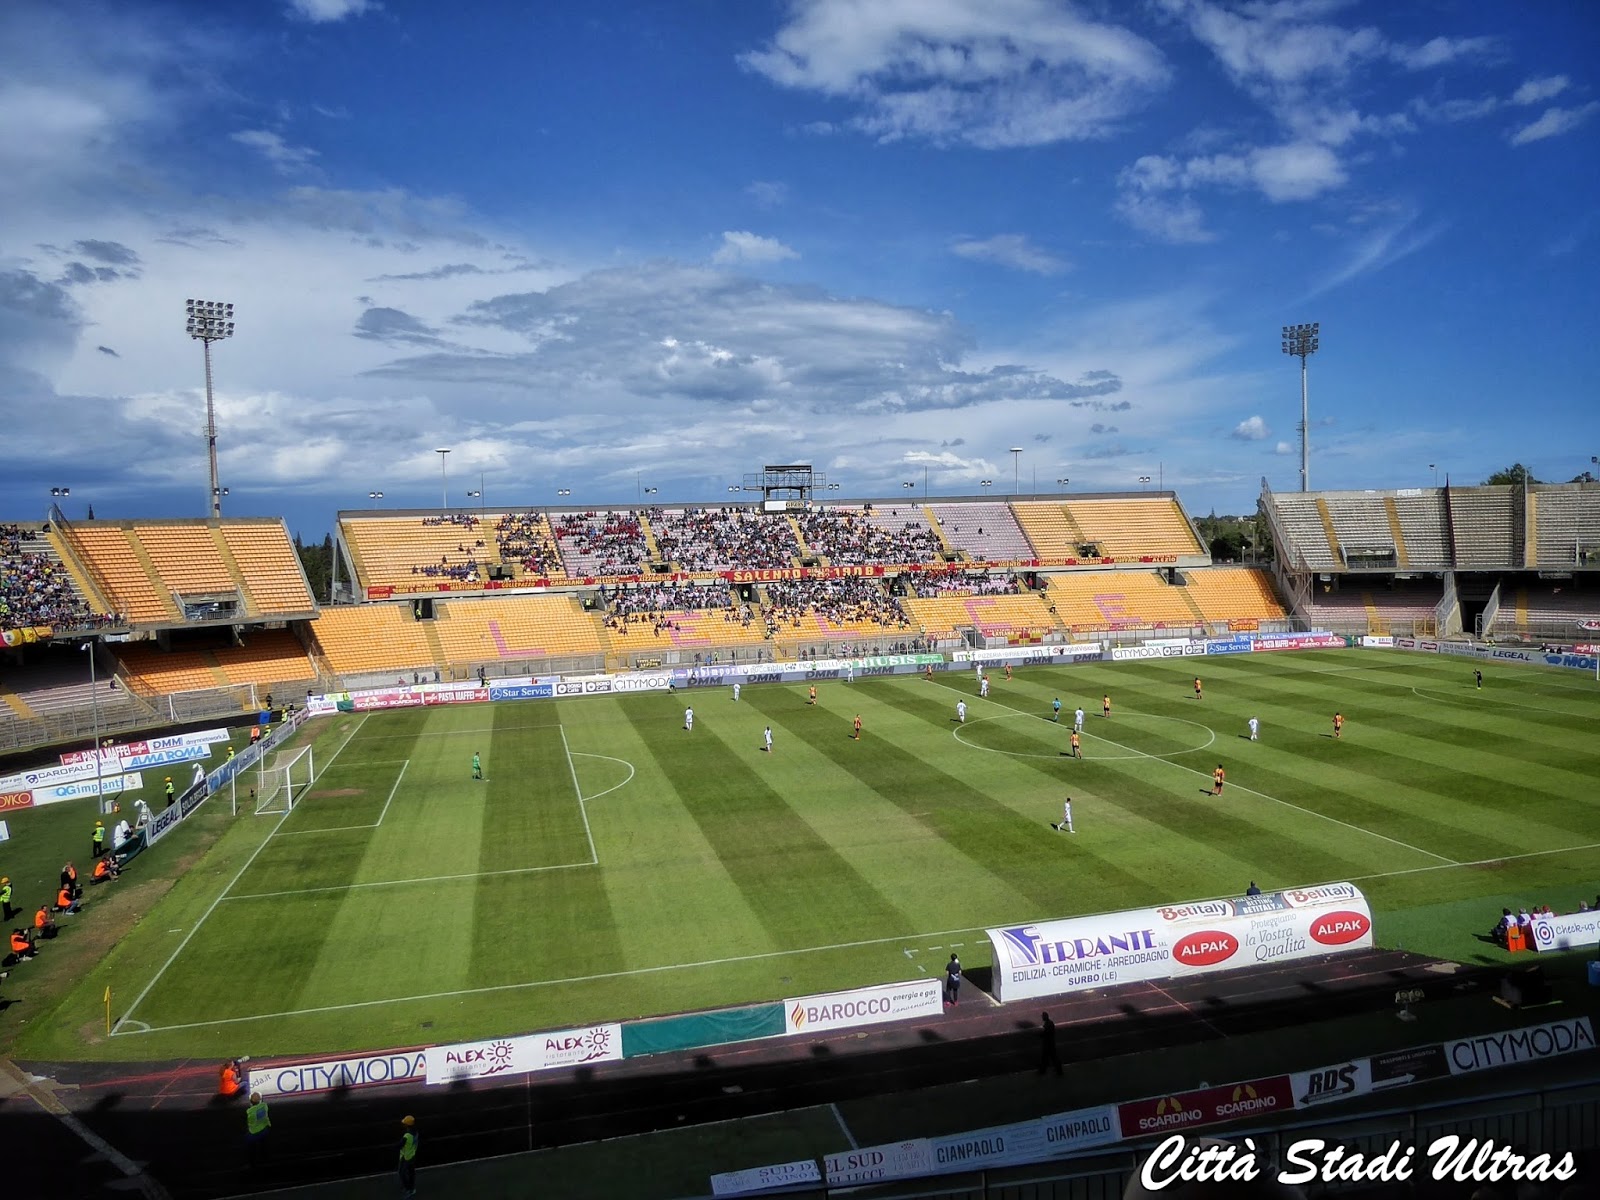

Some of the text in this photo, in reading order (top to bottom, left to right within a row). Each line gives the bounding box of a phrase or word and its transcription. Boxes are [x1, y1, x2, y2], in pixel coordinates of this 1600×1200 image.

[734, 569, 801, 582] SALENTO
[1114, 647, 1161, 658] CITYMODA
[1228, 643, 1250, 651] Service
[1024, 656, 1053, 664] DMM
[1073, 653, 1102, 662] DMM
[1493, 652, 1523, 660] LEGEA
[747, 673, 781, 682] DMM
[806, 670, 838, 678] DMM
[862, 666, 894, 675] DMM
[438, 692, 455, 702] PASTA
[455, 691, 474, 701] MAFFEI
[503, 687, 551, 697] Star Service
[153, 737, 182, 749] DMM
[82, 748, 105, 762] PASTA
[131, 754, 164, 766] ALMA
[167, 746, 204, 759] ROMA
[1288, 885, 1355, 903] Betitaly
[1157, 903, 1228, 921] Betitaly
[1242, 903, 1283, 914] BETITALY.it
[1251, 914, 1296, 930] Proteggiamo
[1317, 919, 1361, 936] ALPAK
[1245, 928, 1293, 946] la Vostra
[1001, 926, 1157, 968] FERRANTE
[1181, 940, 1229, 957] ALPAK
[1255, 937, 1306, 962] Qualità
[1012, 950, 1169, 982] EDILIZIA CERAMICHE ARREDOBAGNO
[1068, 971, 1118, 986] SURBO (LE)
[893, 991, 919, 1001] energia
[807, 997, 891, 1023] BAROCCO
[546, 1036, 584, 1051] ALEX
[1453, 1021, 1593, 1070] CITYMODA
[446, 1049, 486, 1063] ALEX
[546, 1050, 585, 1060] ristorante
[277, 1053, 426, 1094] CITYMODA
[446, 1063, 486, 1072] ristorante
[1308, 1064, 1356, 1094] RDS
[1216, 1096, 1276, 1116] SCARDINO
[1139, 1109, 1202, 1129] SCARDINO
[1046, 1116, 1111, 1142] GIANPAOLO
[937, 1137, 1004, 1163] GIANPAOLO
[848, 1151, 884, 1170] SUD
[759, 1165, 794, 1177] SUD
[777, 1173, 807, 1182] VINO
